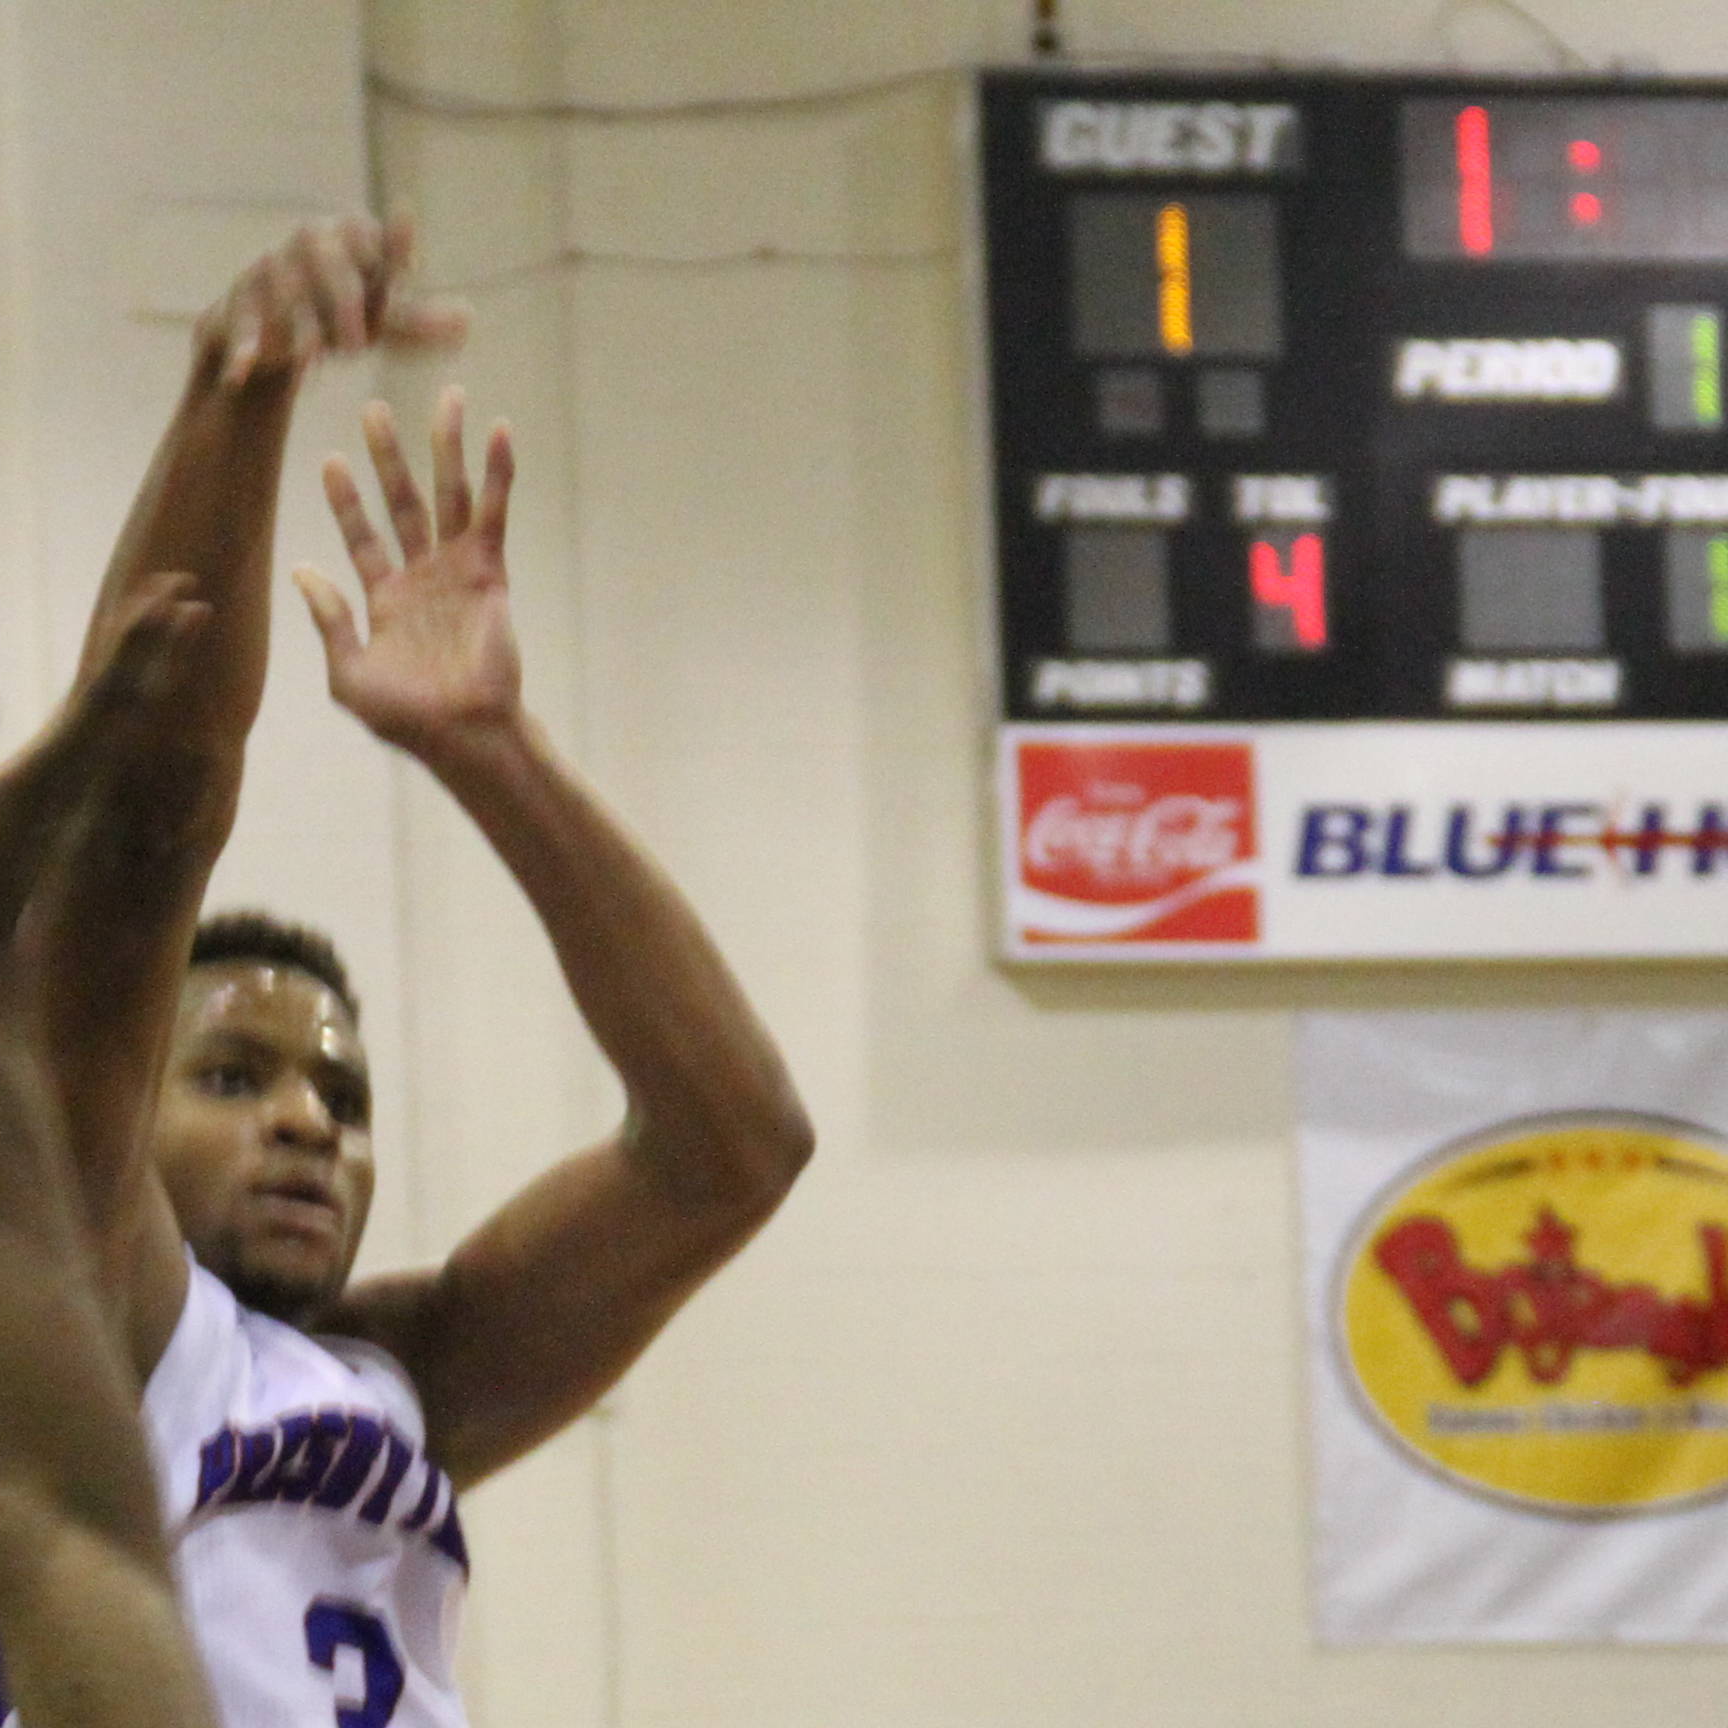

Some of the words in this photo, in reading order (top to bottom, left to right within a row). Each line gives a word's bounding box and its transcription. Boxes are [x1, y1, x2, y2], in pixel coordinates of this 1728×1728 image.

[1040, 100, 1302, 174] GUEST
[1394, 337, 1622, 403] PERIOD
[1249, 532, 1328, 650] 4
[1292, 799, 1606, 882] BLUE
